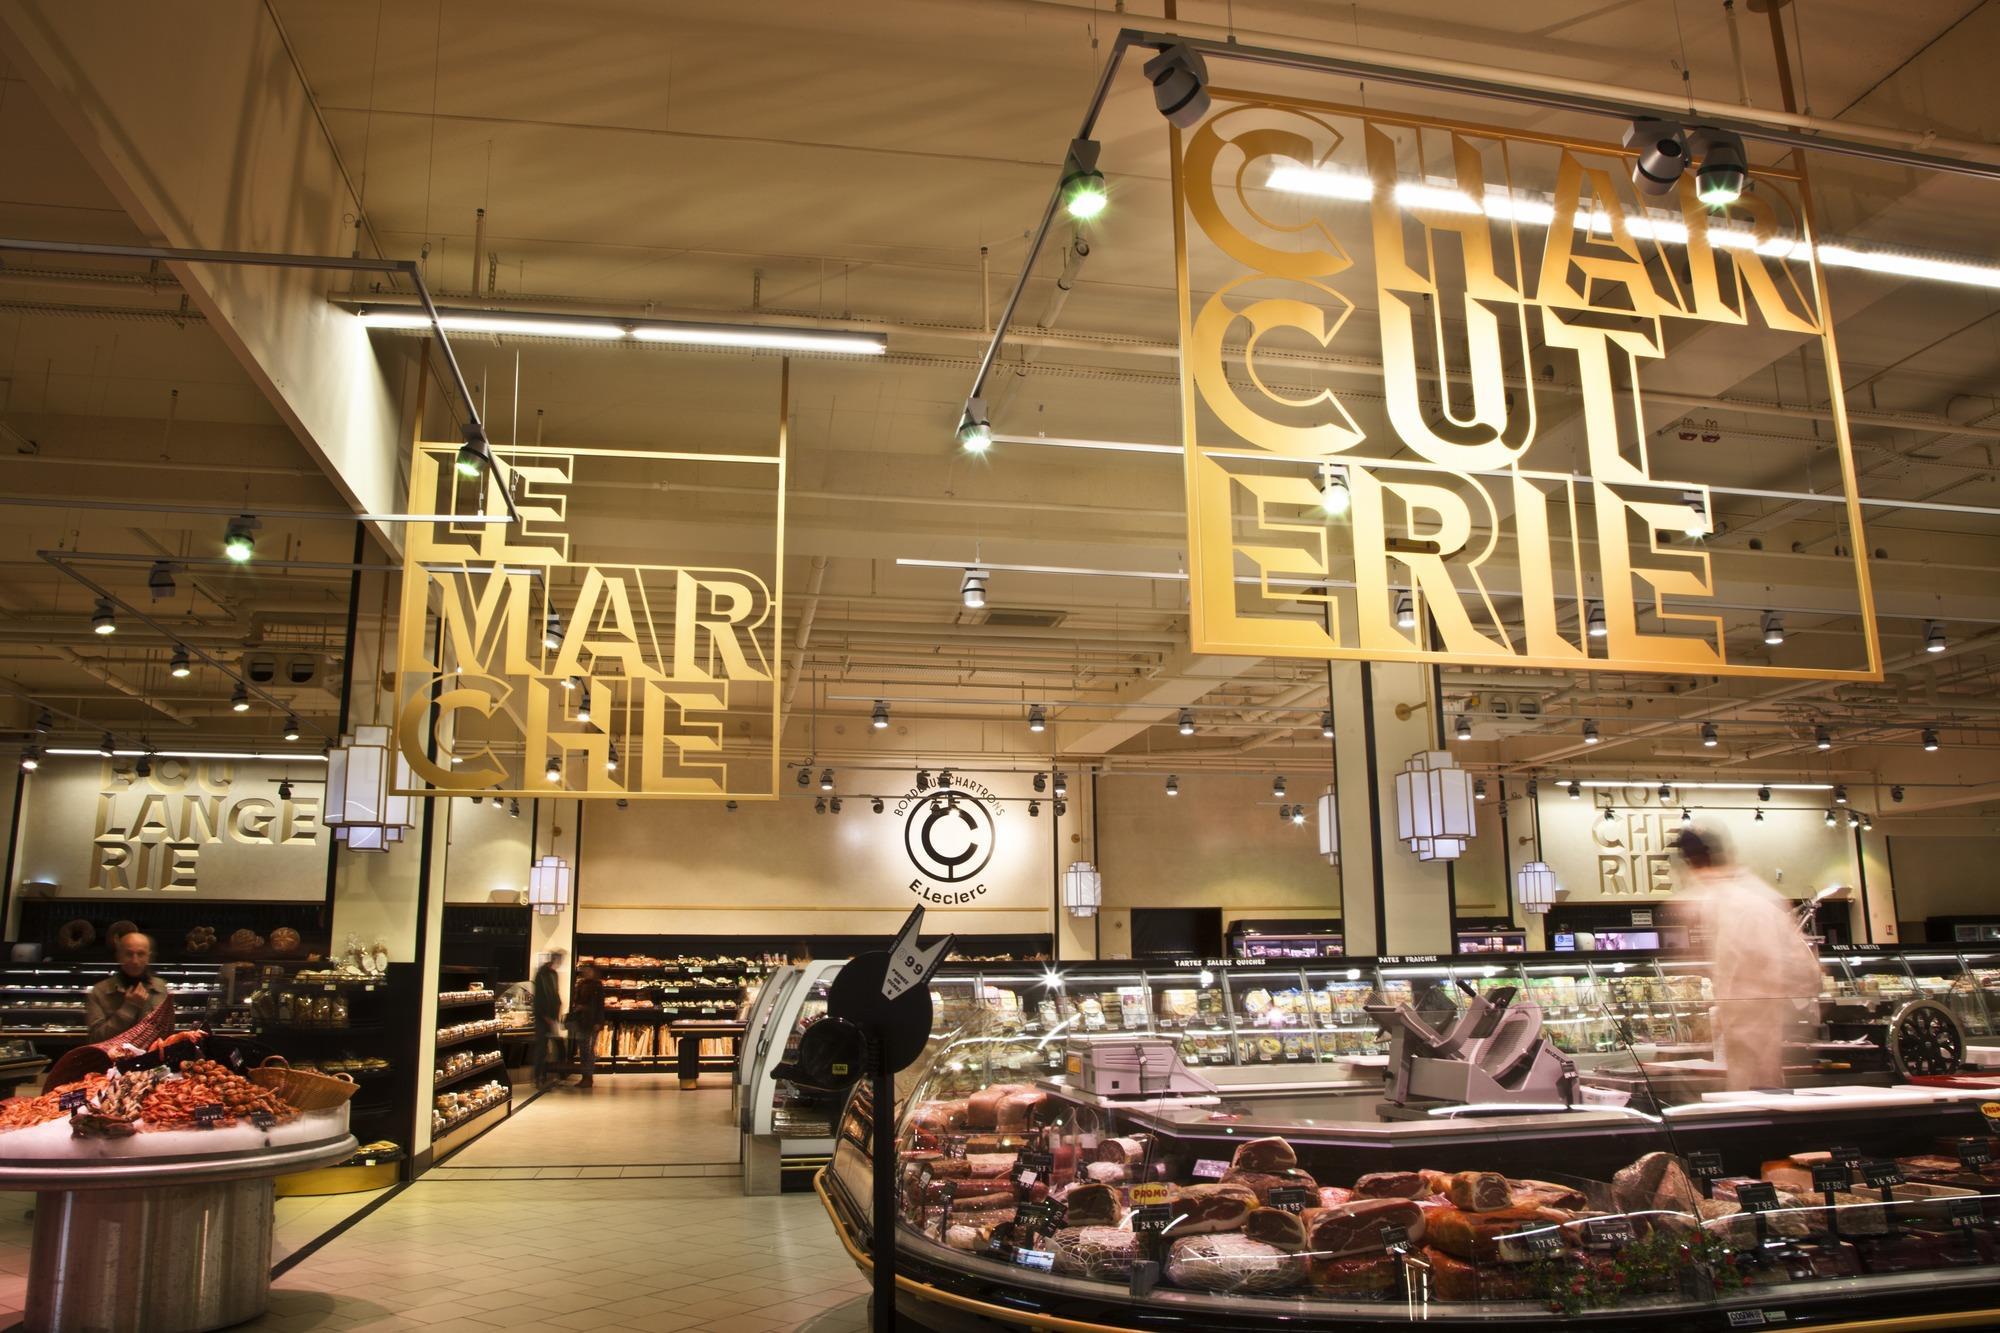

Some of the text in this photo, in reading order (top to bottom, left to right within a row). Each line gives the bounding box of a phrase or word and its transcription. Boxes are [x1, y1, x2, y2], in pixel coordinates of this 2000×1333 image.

[1183, 104, 1823, 334] CHAR
[1193, 272, 1666, 482] CUT
[409, 448, 574, 563] LE
[1197, 447, 1725, 665] ERIE
[402, 560, 773, 681] MAR
[399, 673, 729, 793] CHE
[94, 792, 319, 846] LANGE
[894, 776, 1006, 817] BORDEAU CHARTRONS
[1592, 814, 1682, 854] CHE
[89, 842, 200, 891] RIE
[1598, 854, 1673, 896] RIE
[909, 879, 987, 905] E.Leclerc
[904, 955, 924, 976] 99
[1174, 958, 1266, 967] TARTES SALEES QUICHES
[1378, 955, 1438, 964] PATES FRAICHES
[1133, 1188, 1168, 1199] PROMO
